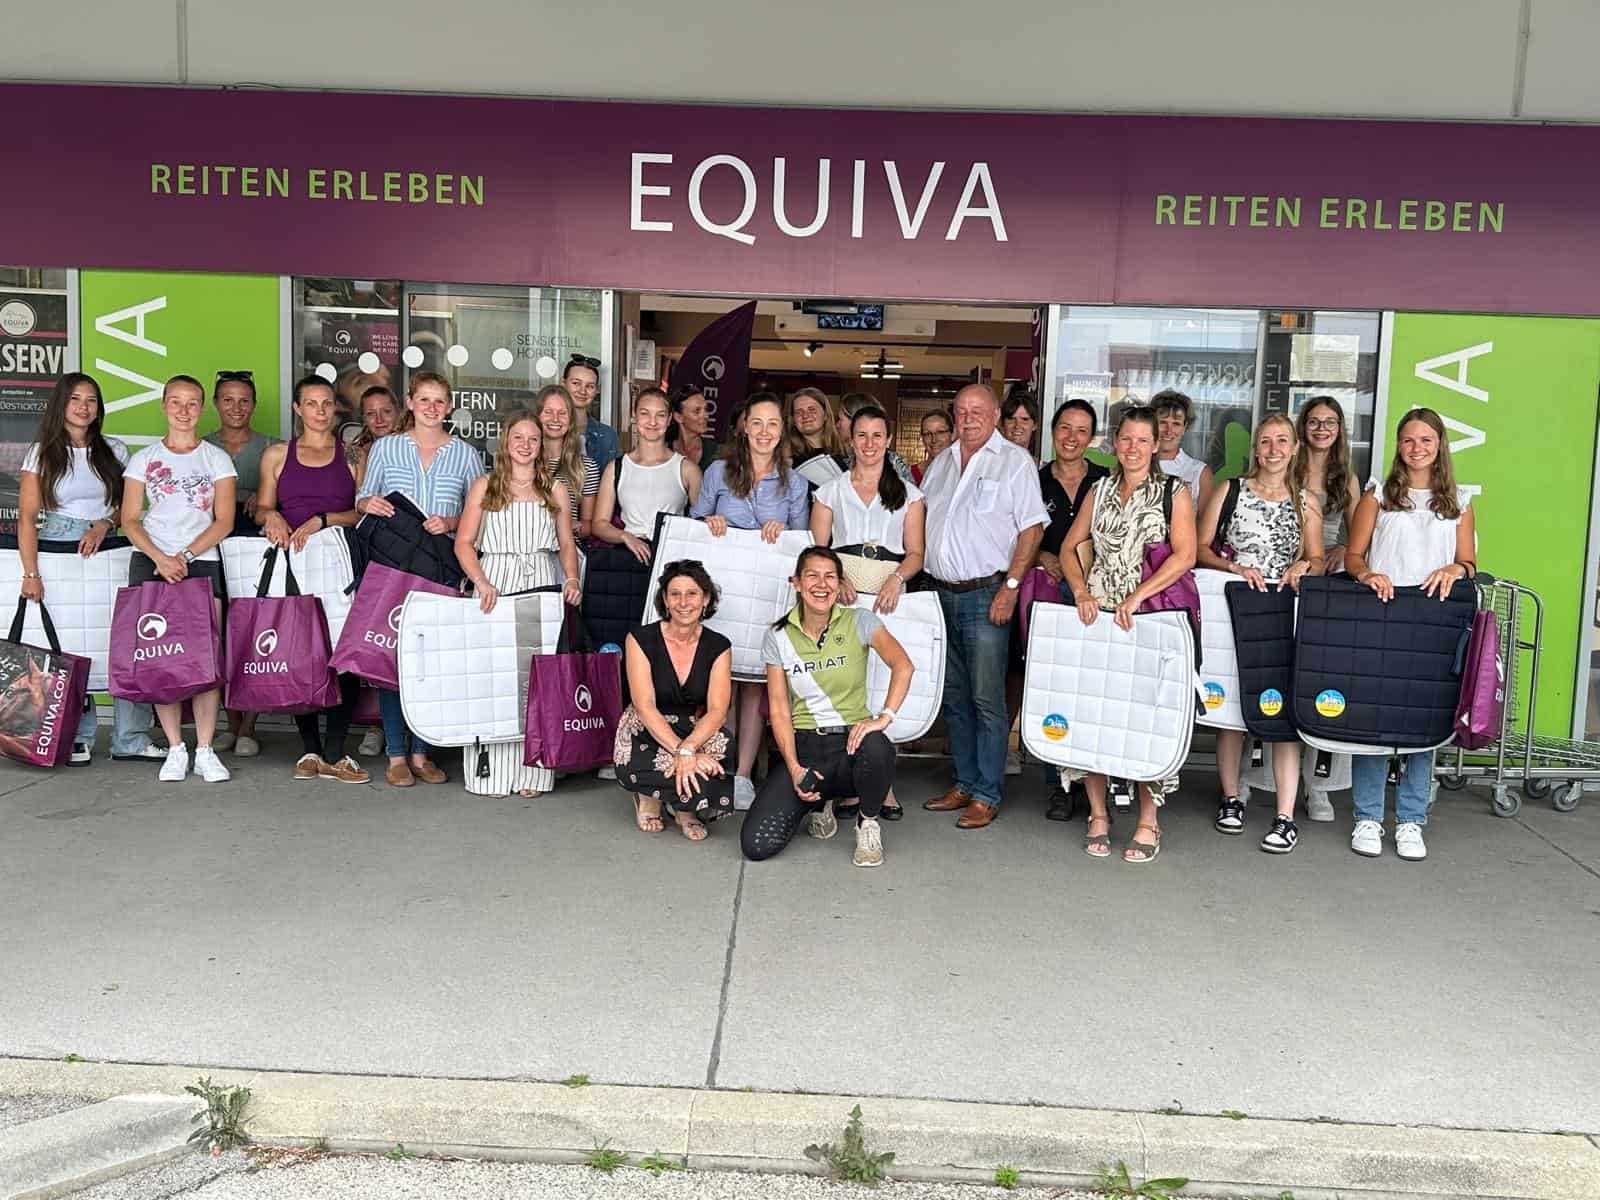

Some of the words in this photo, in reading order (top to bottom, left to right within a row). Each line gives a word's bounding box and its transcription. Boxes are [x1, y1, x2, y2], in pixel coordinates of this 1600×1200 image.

[151, 163, 289, 198] REITEN
[308, 168, 485, 206] ERLEBEN
[630, 152, 1009, 246] EQUIVA
[1154, 194, 1301, 228] REITEN
[1319, 197, 1505, 233] ERLEBEN
[328, 346, 359, 354] EQUIVA
[133, 642, 185, 662] QUIVA
[243, 661, 289, 675] EQUIVA
[792, 655, 847, 675] ARIAT
[36, 668, 68, 756] EQUIVA.COM
[563, 716, 606, 732] EQUIVA
